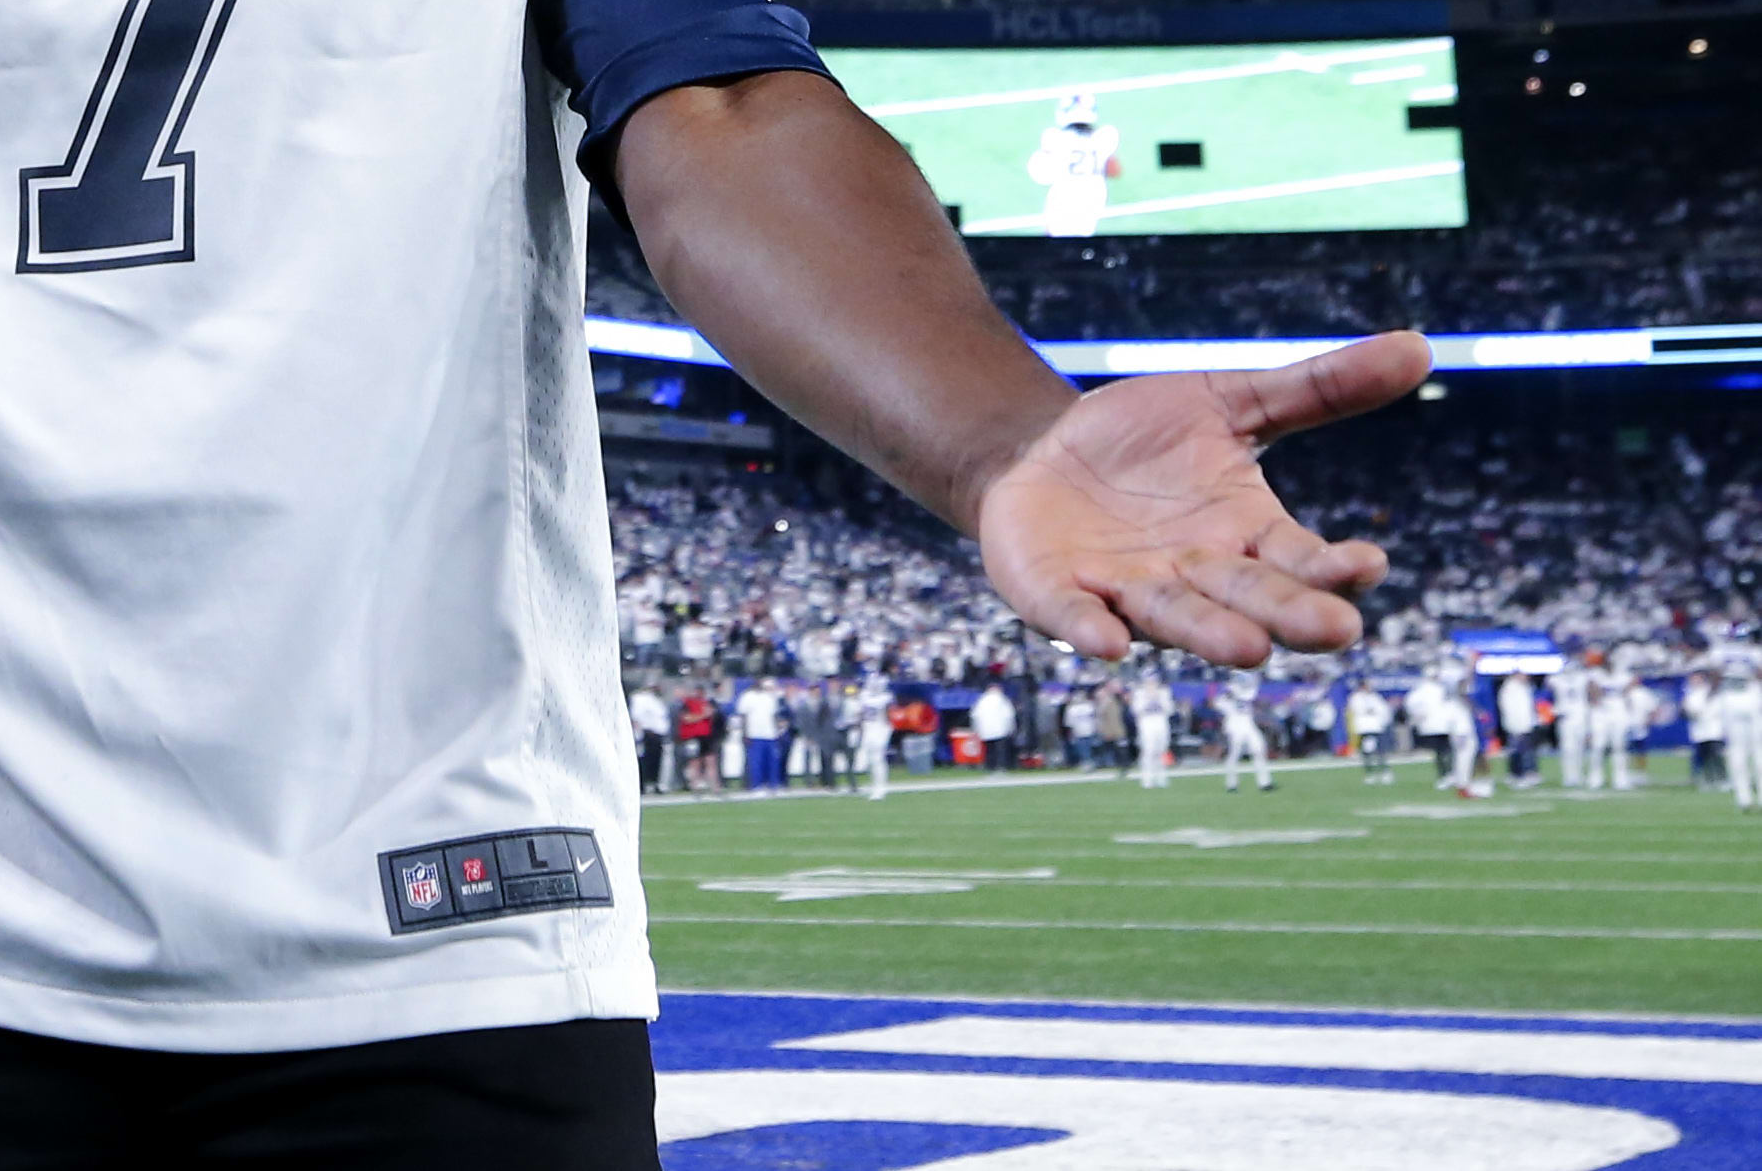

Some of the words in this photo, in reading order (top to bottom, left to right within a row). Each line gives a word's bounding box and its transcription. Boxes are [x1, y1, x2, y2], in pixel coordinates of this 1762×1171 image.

[990, 7, 1162, 40] HCLTech
[1069, 150, 1101, 175] 21
[527, 839, 548, 869] L
[411, 881, 437, 903] NFL
